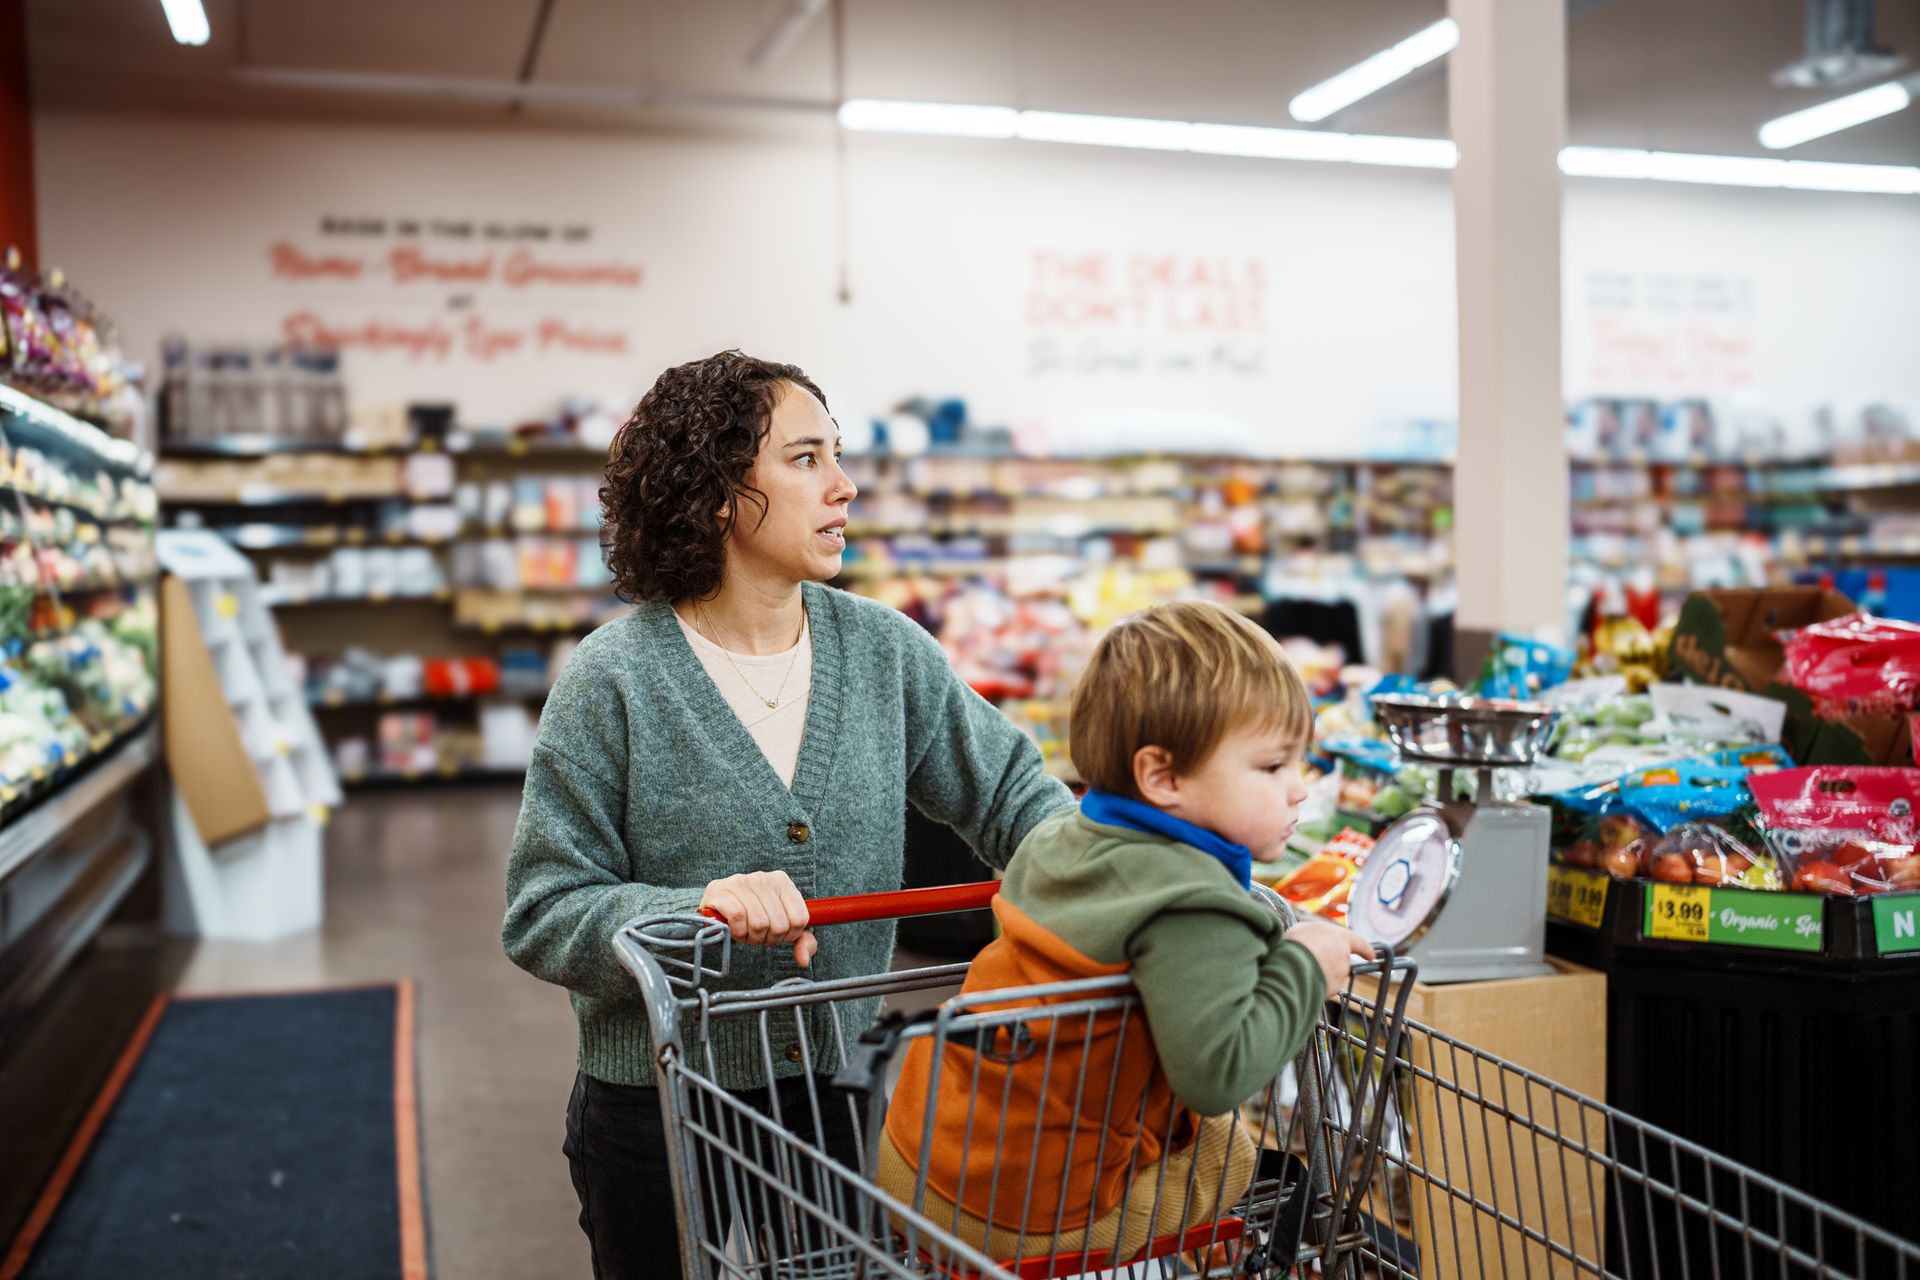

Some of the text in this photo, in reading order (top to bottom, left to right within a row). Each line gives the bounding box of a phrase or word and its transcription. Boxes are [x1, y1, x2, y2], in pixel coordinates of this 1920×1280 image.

[397, 218, 419, 238] IN
[430, 219, 472, 240] THE
[560, 225, 592, 244] OF
[1026, 249, 1268, 292] THE DEALS
[1720, 907, 1778, 933] Organic
